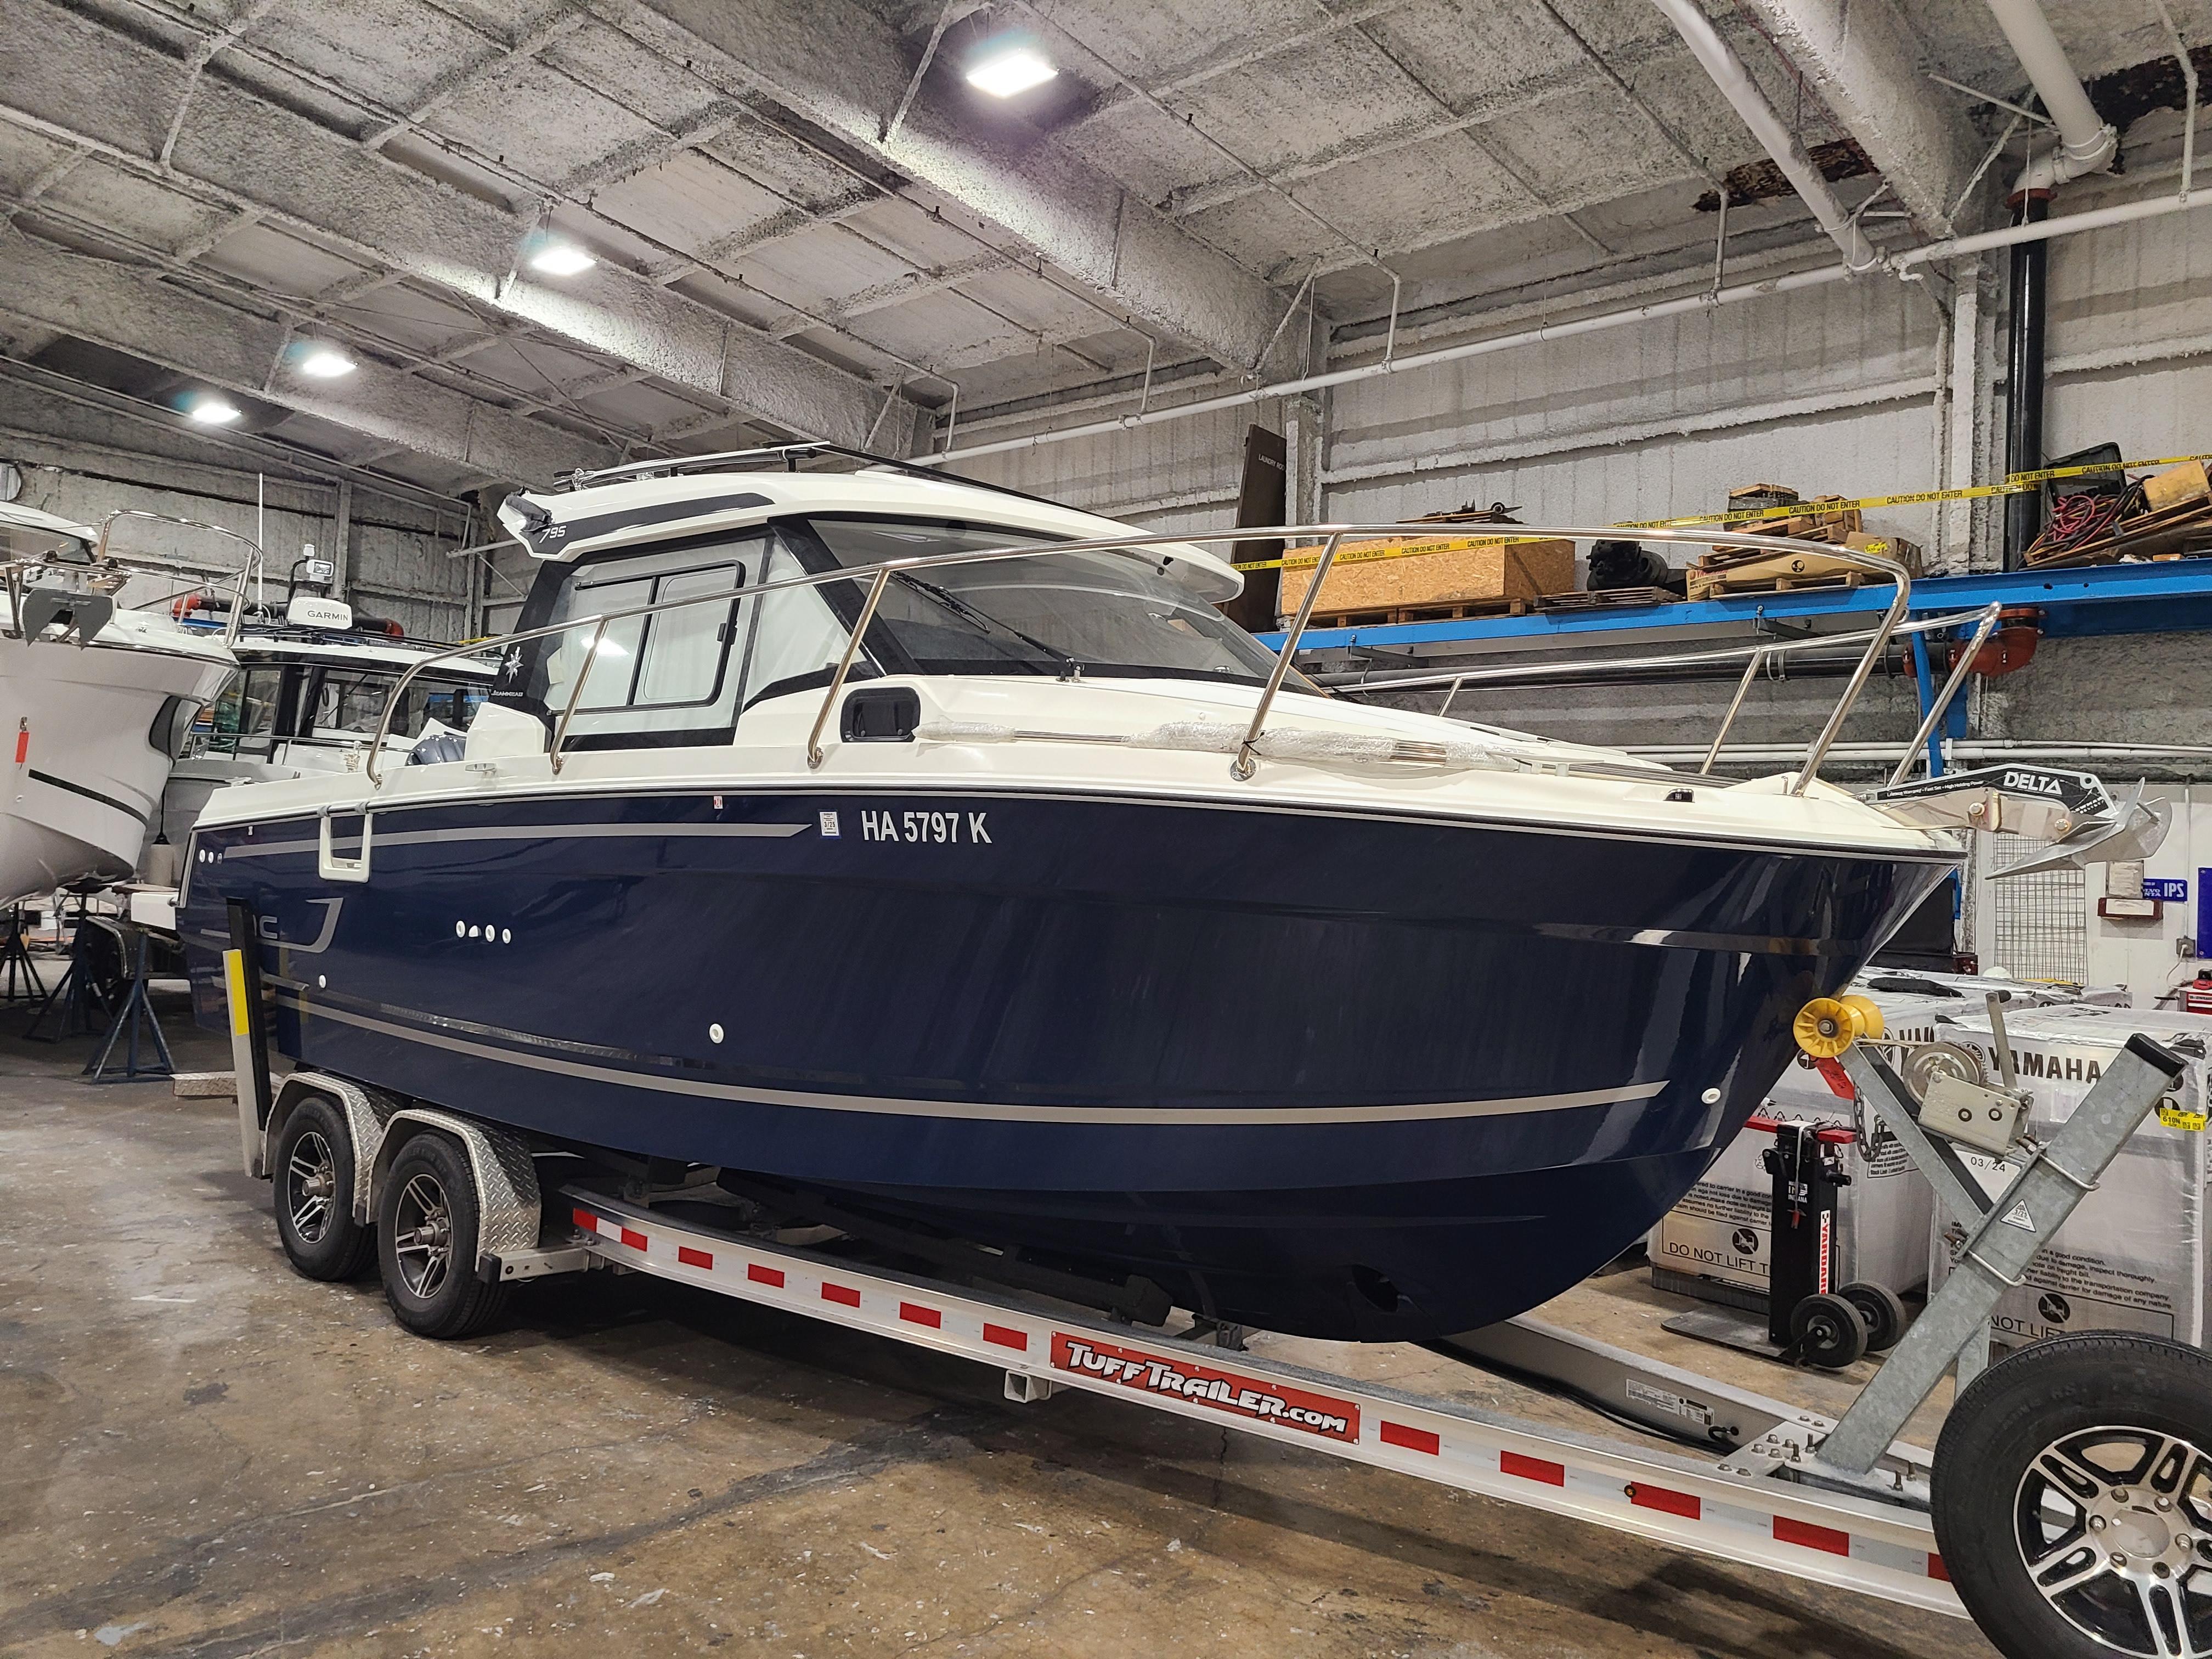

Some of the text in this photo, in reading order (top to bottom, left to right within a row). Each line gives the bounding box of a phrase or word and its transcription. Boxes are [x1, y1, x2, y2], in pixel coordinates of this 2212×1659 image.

[2035, 470, 2055, 479] ENTER
[1887, 494, 1914, 504] CAUTION
[1942, 490, 1962, 499] ENTER
[1789, 504, 1815, 514] CAUTION
[1841, 500, 1860, 509] ENTER
[539, 526, 566, 543] 795
[307, 611, 348, 621] GARMIN
[2004, 771, 2062, 795] DELTA
[861, 810, 992, 843] HA 5797 K
[2164, 883, 2184, 898] IPS
[1971, 1156, 2006, 1172] 03/24
[1670, 1242, 1689, 1256] DO
[1694, 1248, 1723, 1263] NOT
[1727, 1255, 1756, 1271] LIFT
[2057, 1267, 2076, 1276] freight
[2089, 1266, 2115, 1276] inspect
[2034, 1277, 2057, 1286] against
[2093, 1290, 2122, 1300] damage
[2148, 1300, 2171, 1309] nature
[2084, 1280, 2133, 1295] transportation
[1991, 1315, 2025, 1332] NOT
